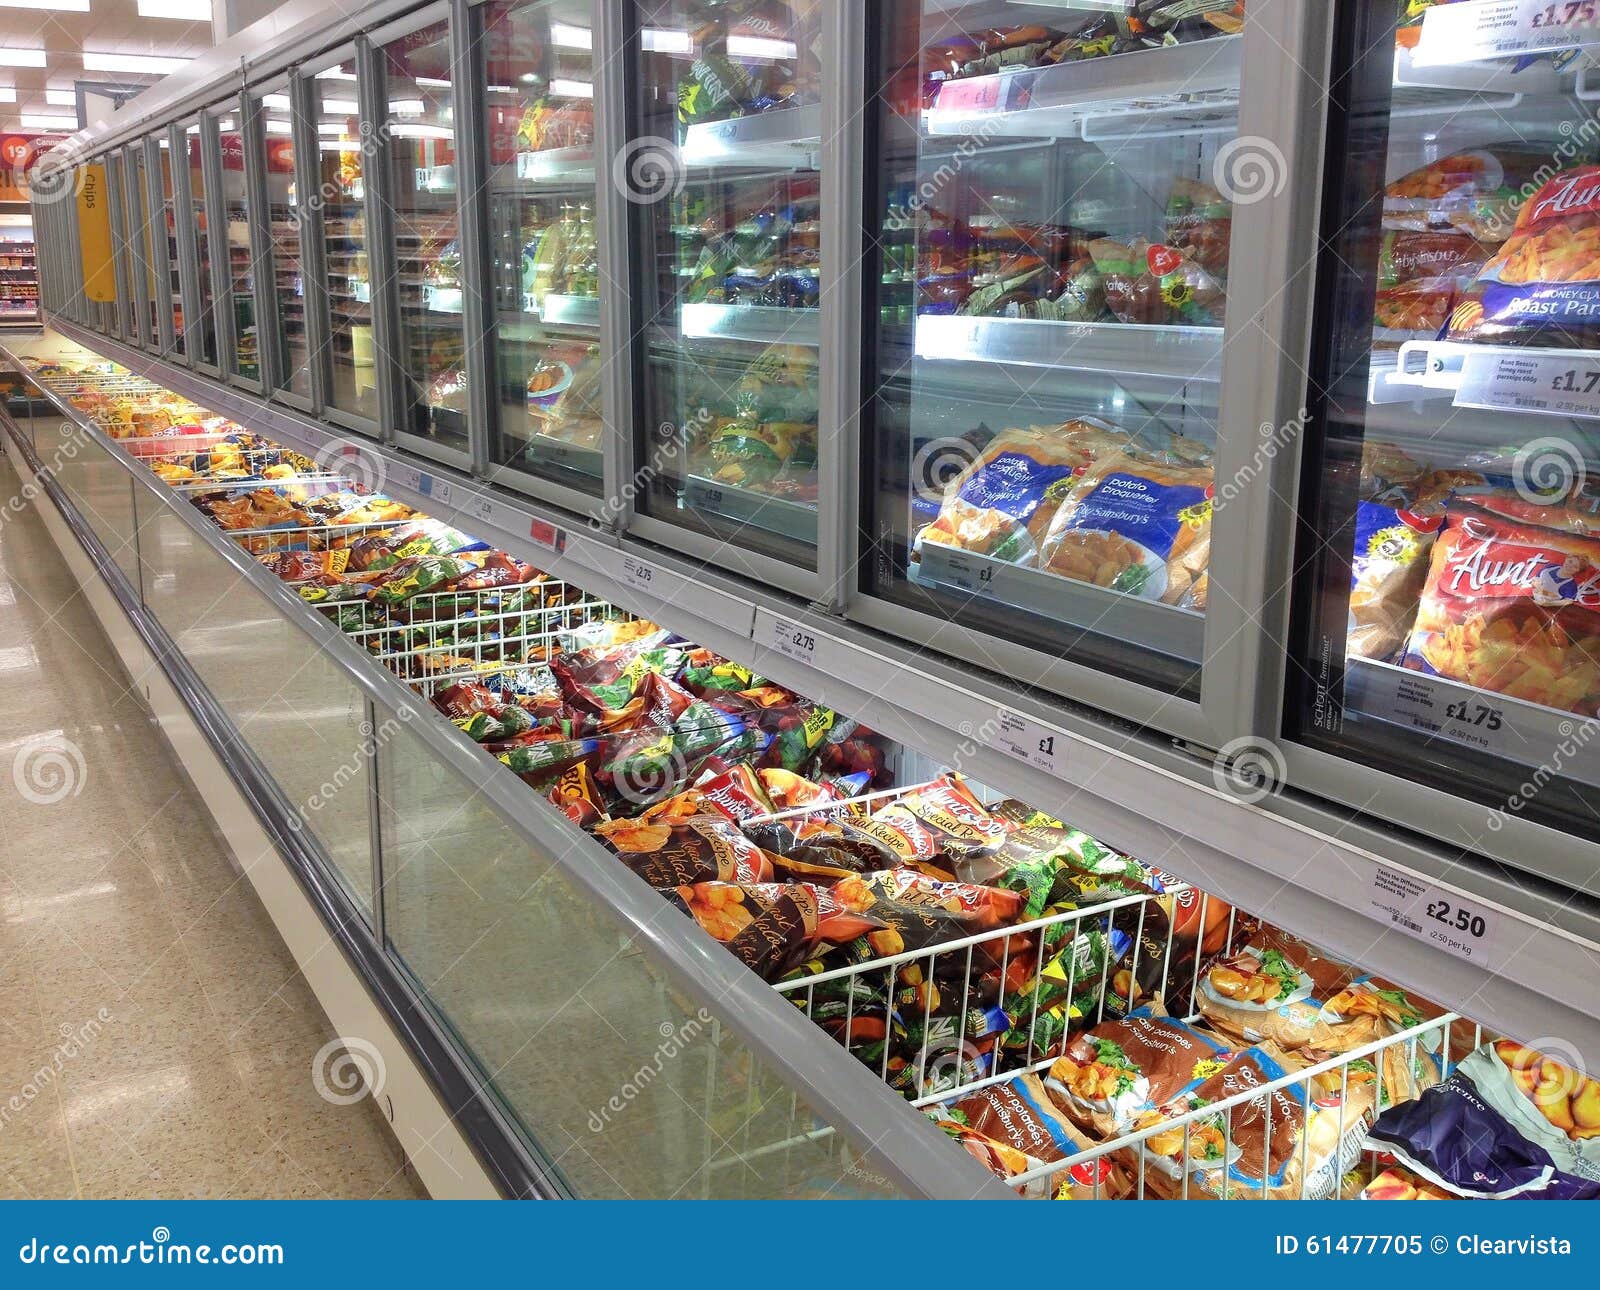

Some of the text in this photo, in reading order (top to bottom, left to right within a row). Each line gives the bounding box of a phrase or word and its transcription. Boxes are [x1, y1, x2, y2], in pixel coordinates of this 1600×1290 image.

[1532, 0, 1596, 28] £1.75
[7, 145, 27, 159] 19
[85, 174, 96, 209] Chips
[1551, 369, 1600, 393] £1.7
[1108, 478, 1148, 491] potato
[1093, 507, 1151, 525] Sainsbury's
[1449, 534, 1549, 592] Aunt
[792, 632, 815, 652] £2.75
[1446, 701, 1503, 731] £1.75
[1039, 736, 1054, 756] £1
[871, 821, 906, 850] Recipe
[1391, 872, 1400, 881] the
[1426, 900, 1486, 937] £2.50
[1448, 937, 1462, 950] per
[1461, 943, 1472, 956] kg
[1129, 1027, 1177, 1055] Sainsbury's
[1153, 1029, 1193, 1050] potatoes
[986, 1092, 1025, 1149] Sainsbury's
[1009, 1098, 1044, 1146] potatoes
